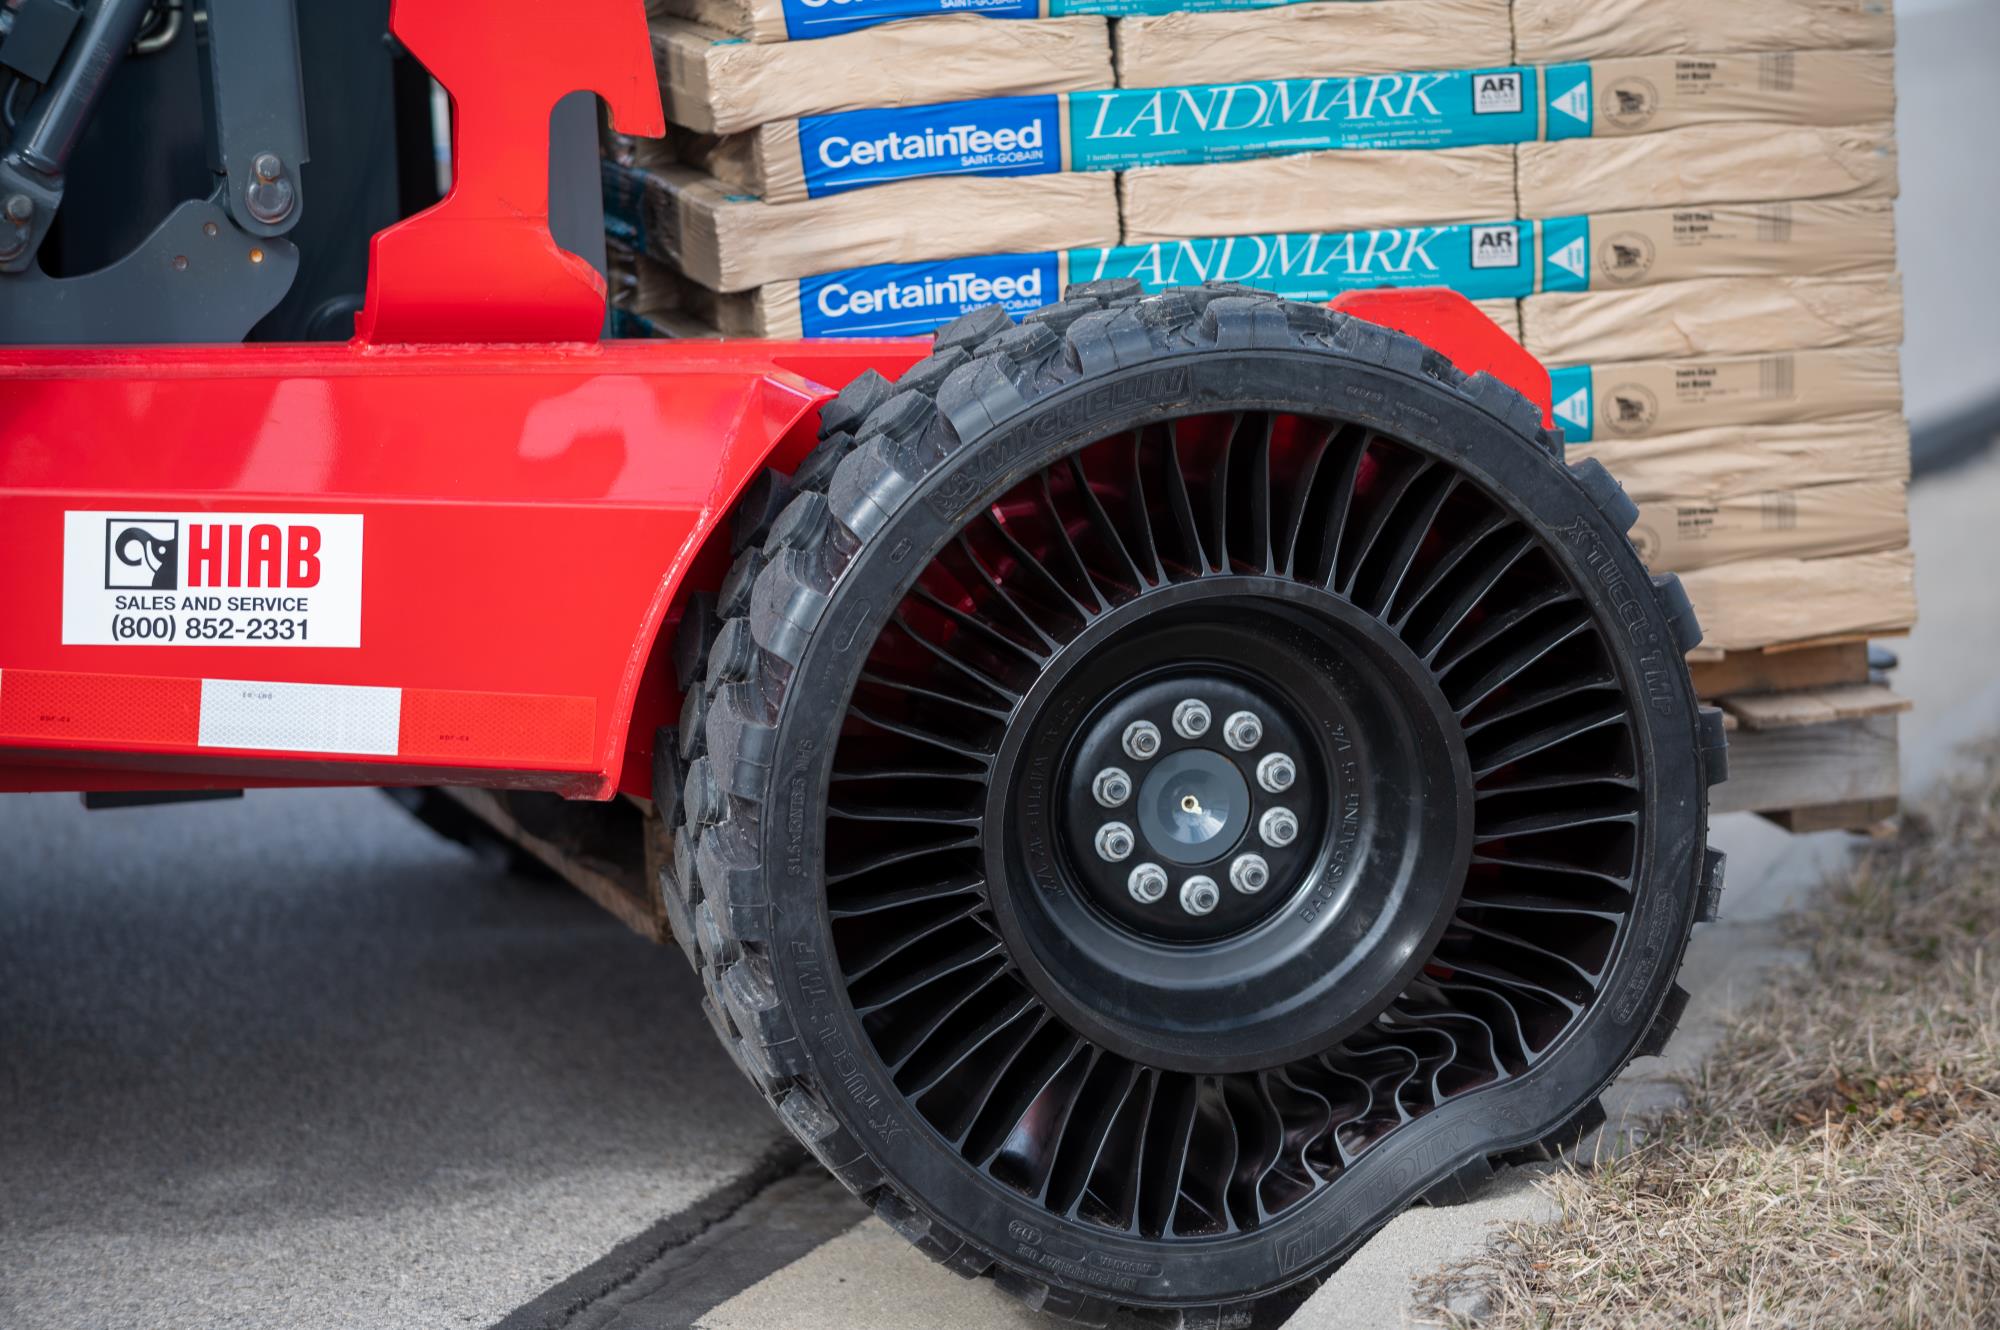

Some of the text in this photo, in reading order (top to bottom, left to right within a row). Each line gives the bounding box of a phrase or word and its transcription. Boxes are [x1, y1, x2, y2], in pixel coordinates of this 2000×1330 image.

[1481, 77, 1515, 93] AR
[1086, 73, 1452, 140] LANDMARK
[819, 118, 1043, 168] CertainTeed
[960, 150, 1044, 167] SAINT-GOBAIN
[1479, 230, 1513, 248] AR
[818, 267, 1042, 318] CertainTeed
[978, 365, 1192, 468] MICHELIN
[188, 523, 322, 589] HIAB
[115, 595, 309, 612] SALES AND SERVICE
[112, 613, 308, 642] (800) 852-2331
